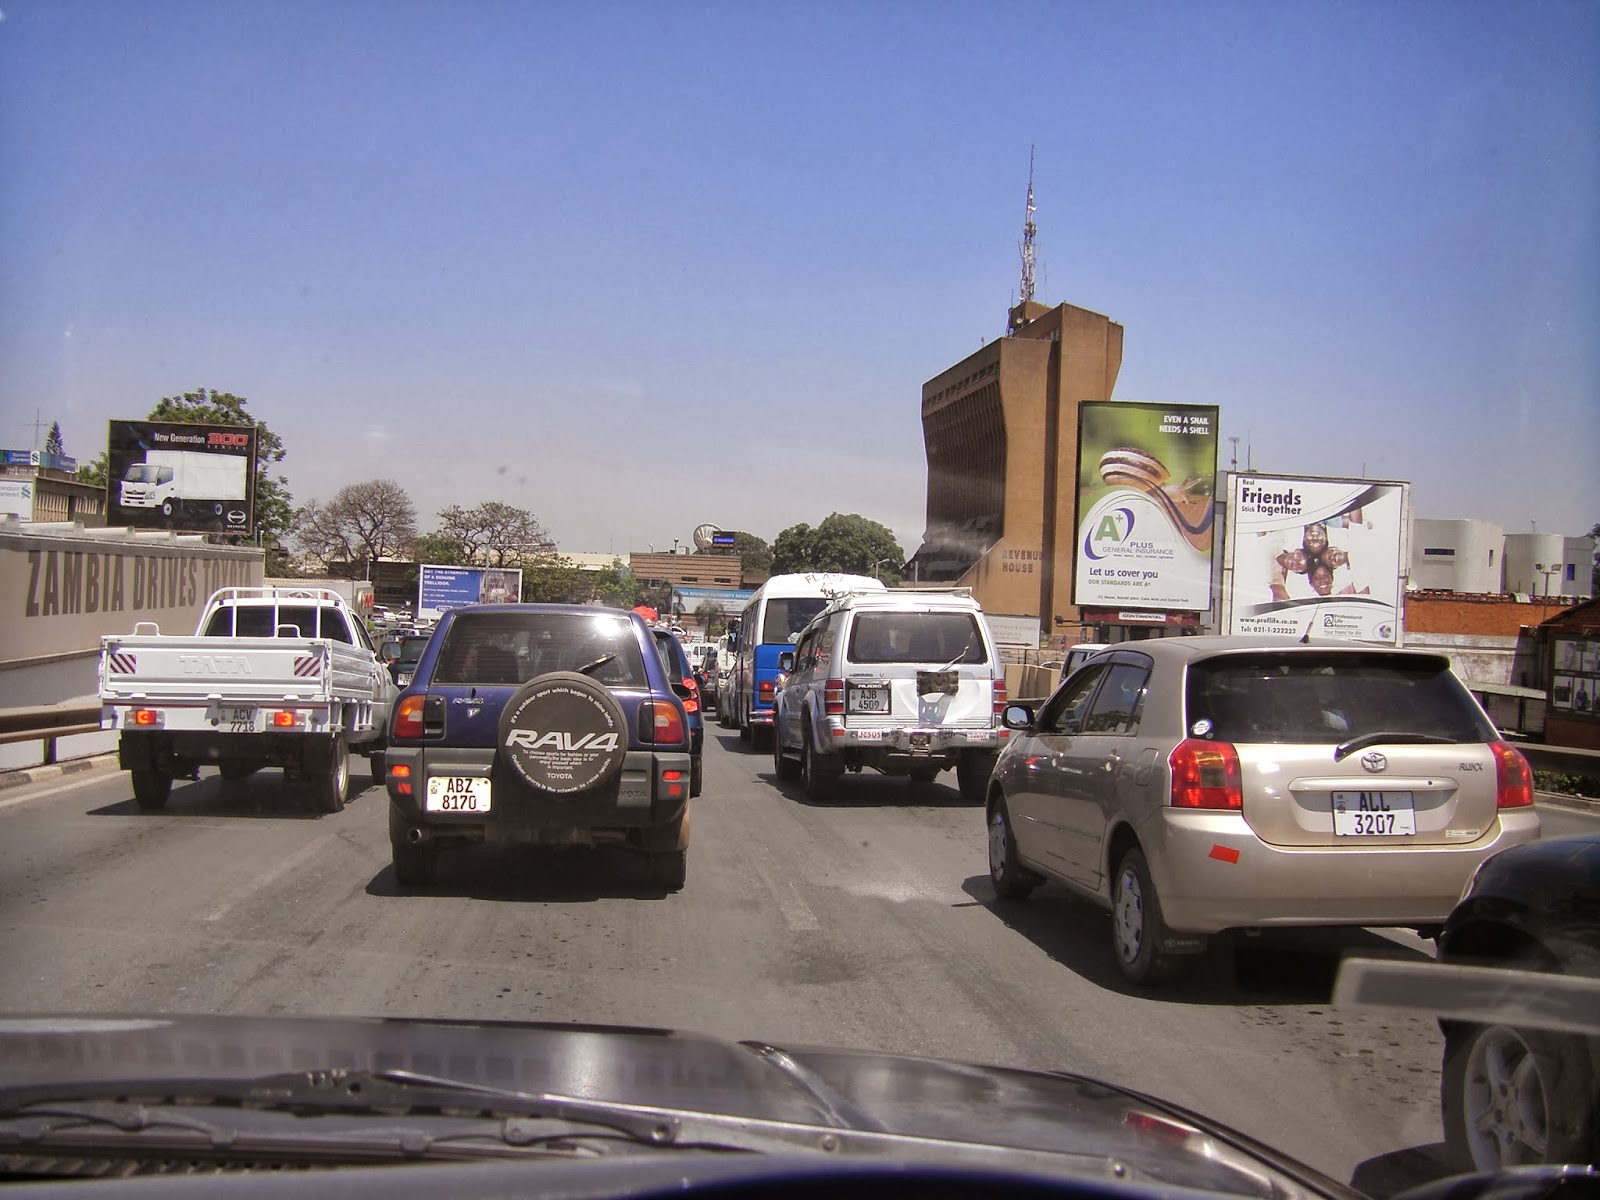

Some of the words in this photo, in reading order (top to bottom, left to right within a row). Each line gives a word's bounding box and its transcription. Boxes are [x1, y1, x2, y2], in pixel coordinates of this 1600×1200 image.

[1190, 416, 1209, 425] SNAIL
[1159, 425, 1181, 433] NEEDS
[154, 432, 169, 442] New
[170, 434, 205, 443] Generation
[208, 432, 248, 446] 300
[1242, 487, 1301, 505] Friends
[1257, 504, 1302, 516] together
[1002, 550, 1042, 560] REVENUE
[1002, 563, 1033, 573] HOUSE
[1090, 567, 1102, 576] Let
[1143, 571, 1158, 580] you
[26, 550, 124, 617] ZAMBIA
[133, 556, 198, 611] DRIVES
[180, 655, 252, 674] TATA
[860, 690, 877, 700] AJB
[858, 700, 879, 710] 4509
[234, 709, 252, 720] ACV
[231, 721, 255, 731] 7718
[505, 729, 618, 752] RAV4
[1459, 762, 1483, 771] RUNX
[447, 779, 473, 793] ABZ
[442, 795, 476, 810] 8170
[1359, 793, 1390, 812] ALL
[1354, 814, 1395, 834] 3207
